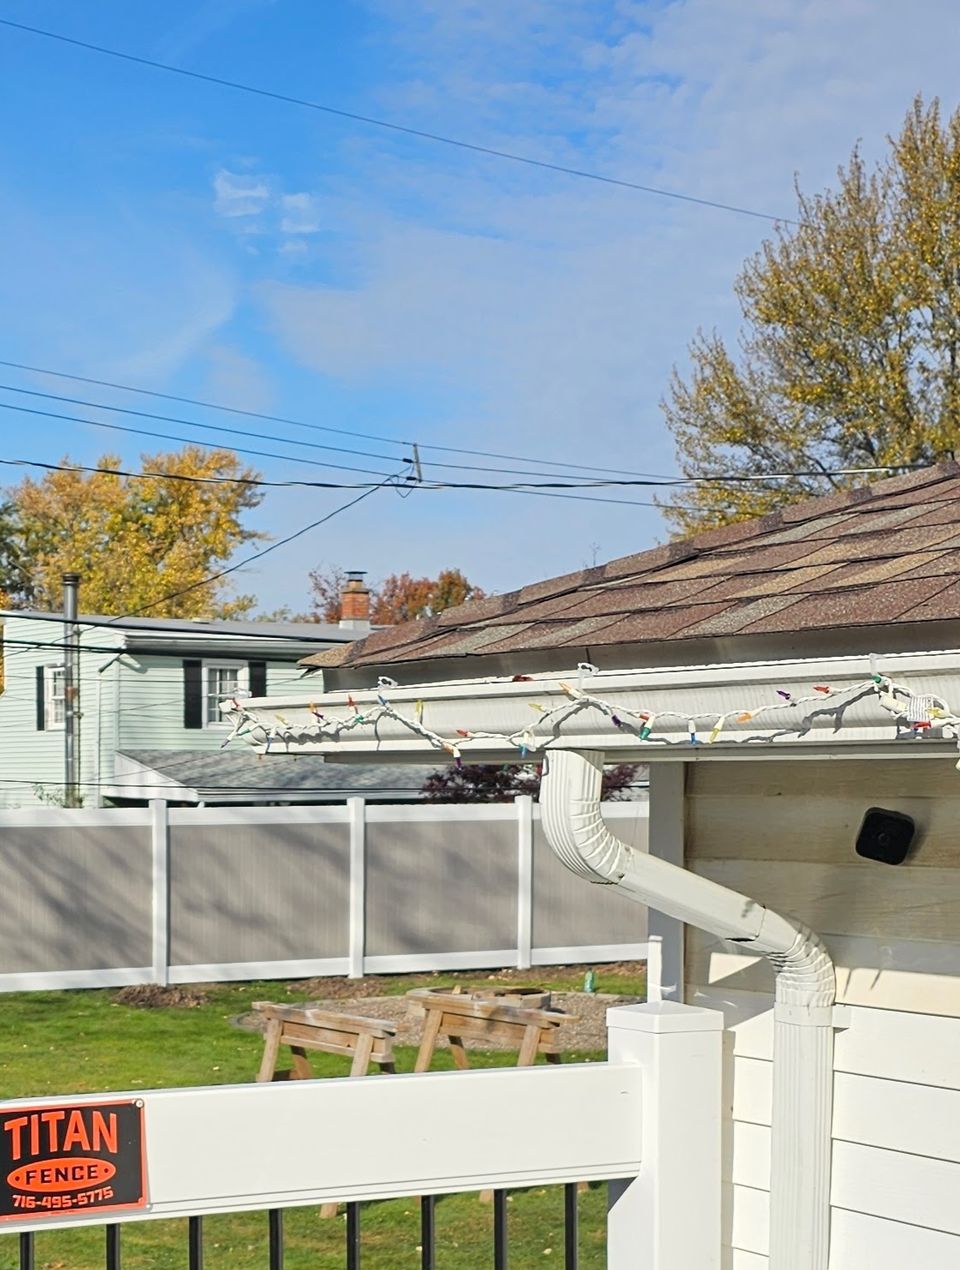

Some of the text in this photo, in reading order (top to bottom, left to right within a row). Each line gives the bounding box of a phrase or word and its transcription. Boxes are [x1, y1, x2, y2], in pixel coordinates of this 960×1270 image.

[4, 1110, 118, 1160] TITAN
[25, 1165, 98, 1185] FENCE
[12, 1186, 114, 1209] 716-495-5775
